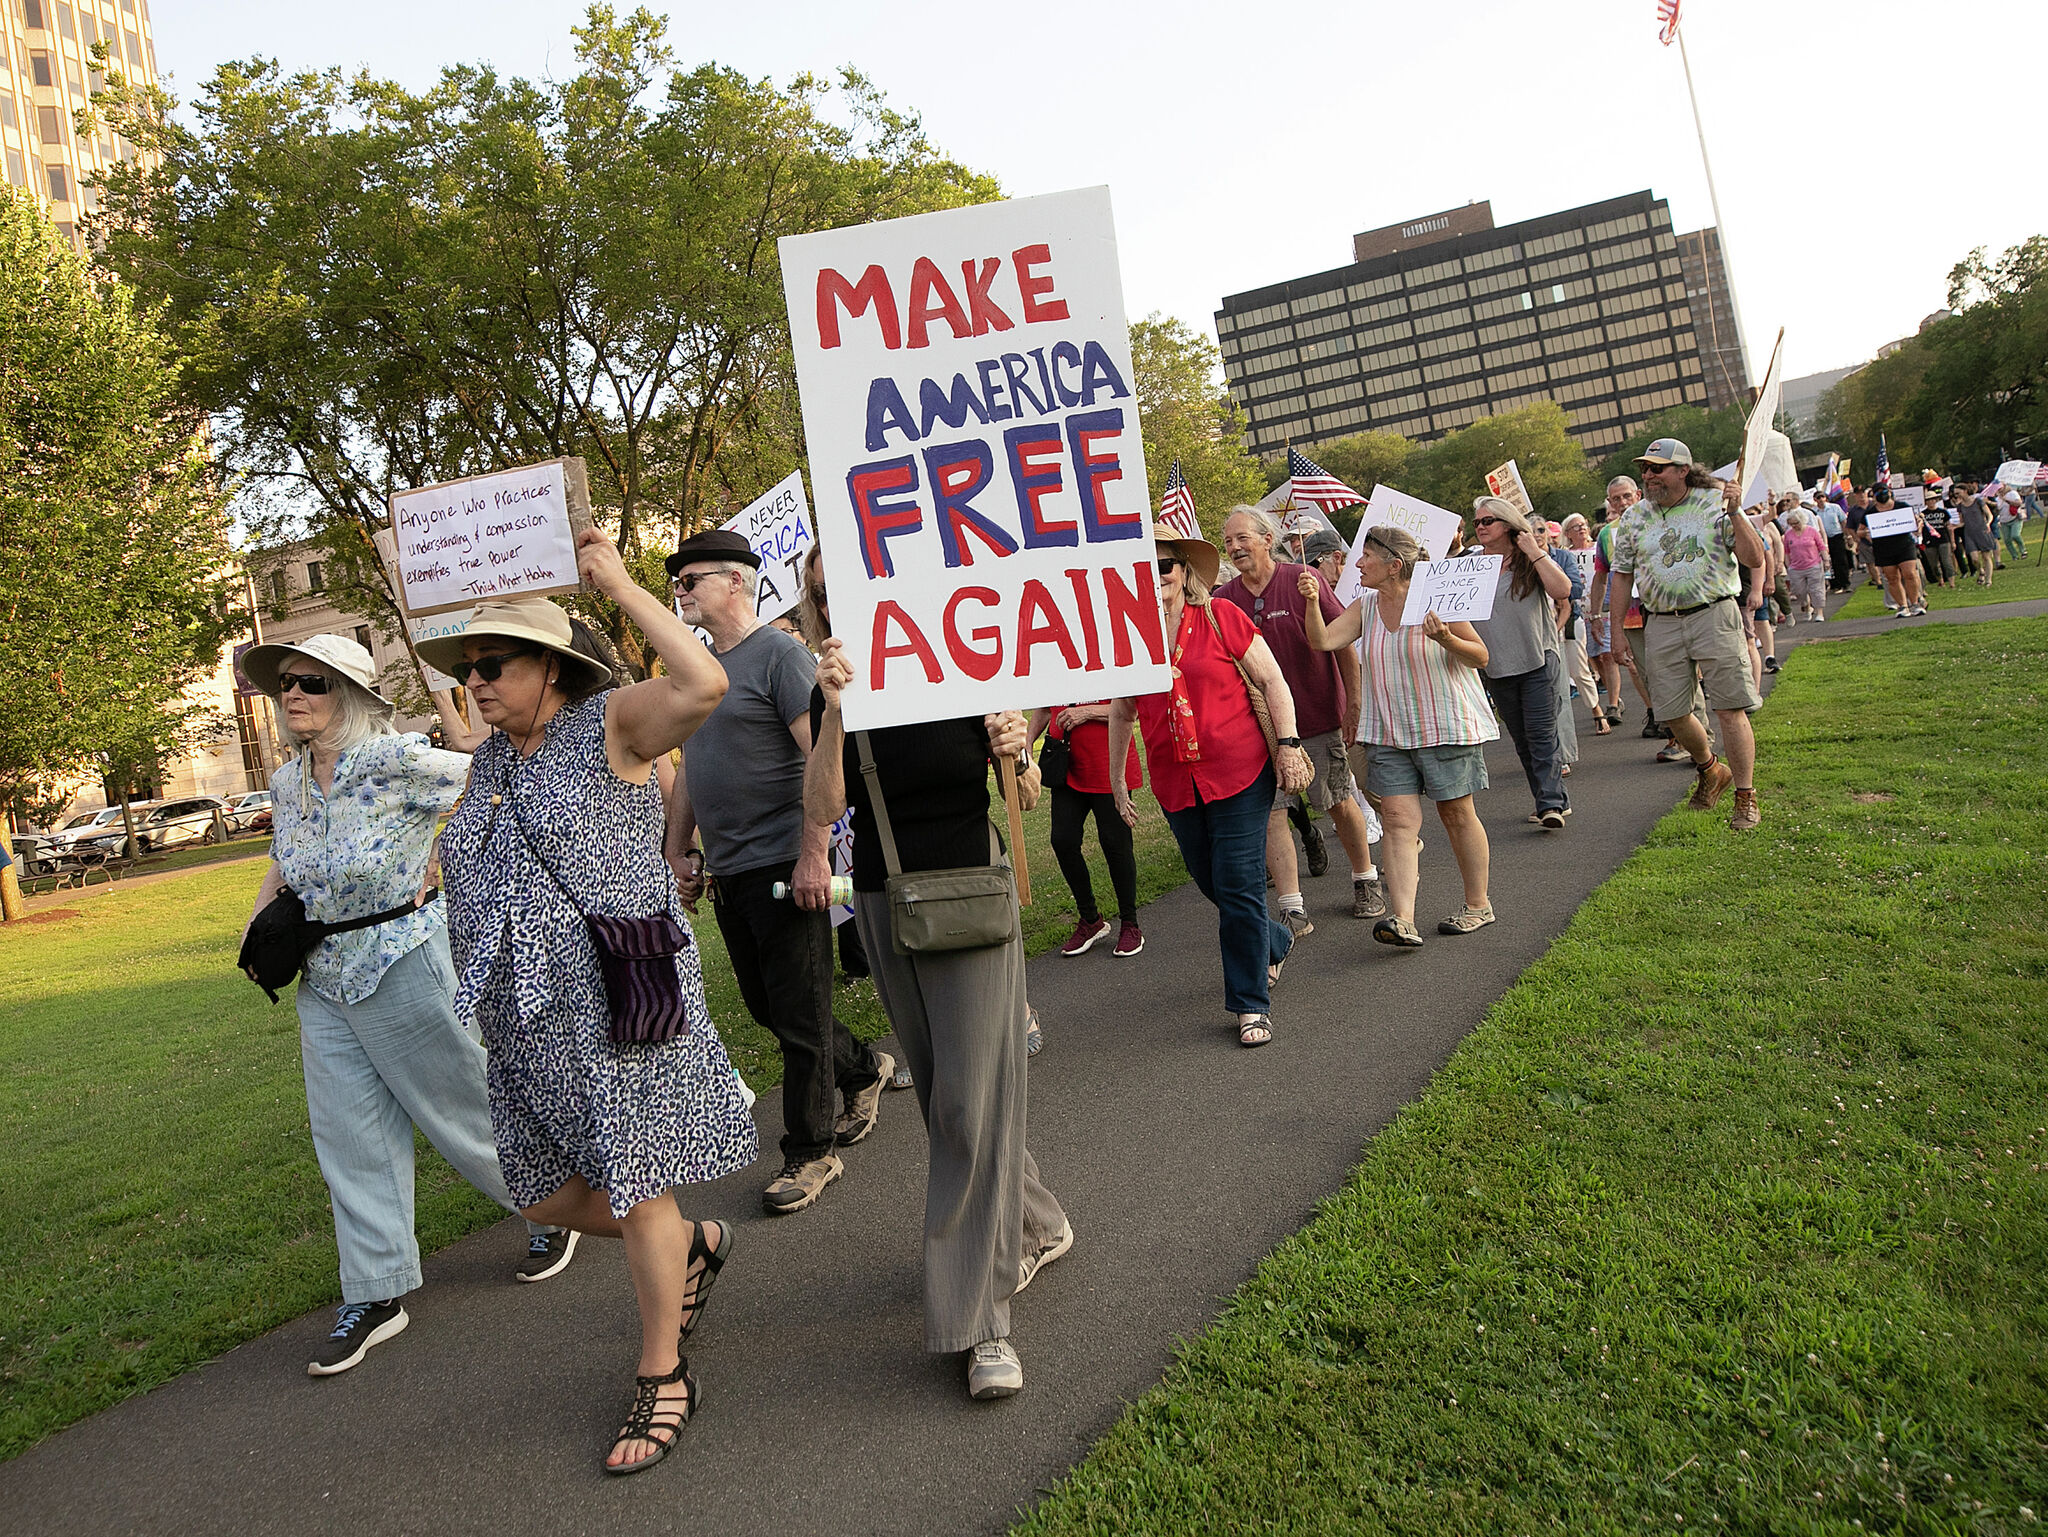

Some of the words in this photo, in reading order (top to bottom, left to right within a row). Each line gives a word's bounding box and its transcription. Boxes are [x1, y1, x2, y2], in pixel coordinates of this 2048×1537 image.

[816, 244, 1071, 349] MAKE
[865, 340, 1131, 452] AMERICA
[846, 407, 1143, 580] FREE
[400, 506, 457, 534] Anyone
[750, 489, 795, 530] NEVER
[1386, 503, 1428, 534] NEVER
[474, 523, 480, 543] &
[486, 514, 548, 538] compassion
[458, 557, 483, 573] true
[1426, 560, 1451, 577] NO
[1455, 556, 1496, 573] KINGS
[1435, 578, 1476, 589] SINCE
[1425, 587, 1479, 613] 1776!
[870, 560, 1166, 691] AGAIN
